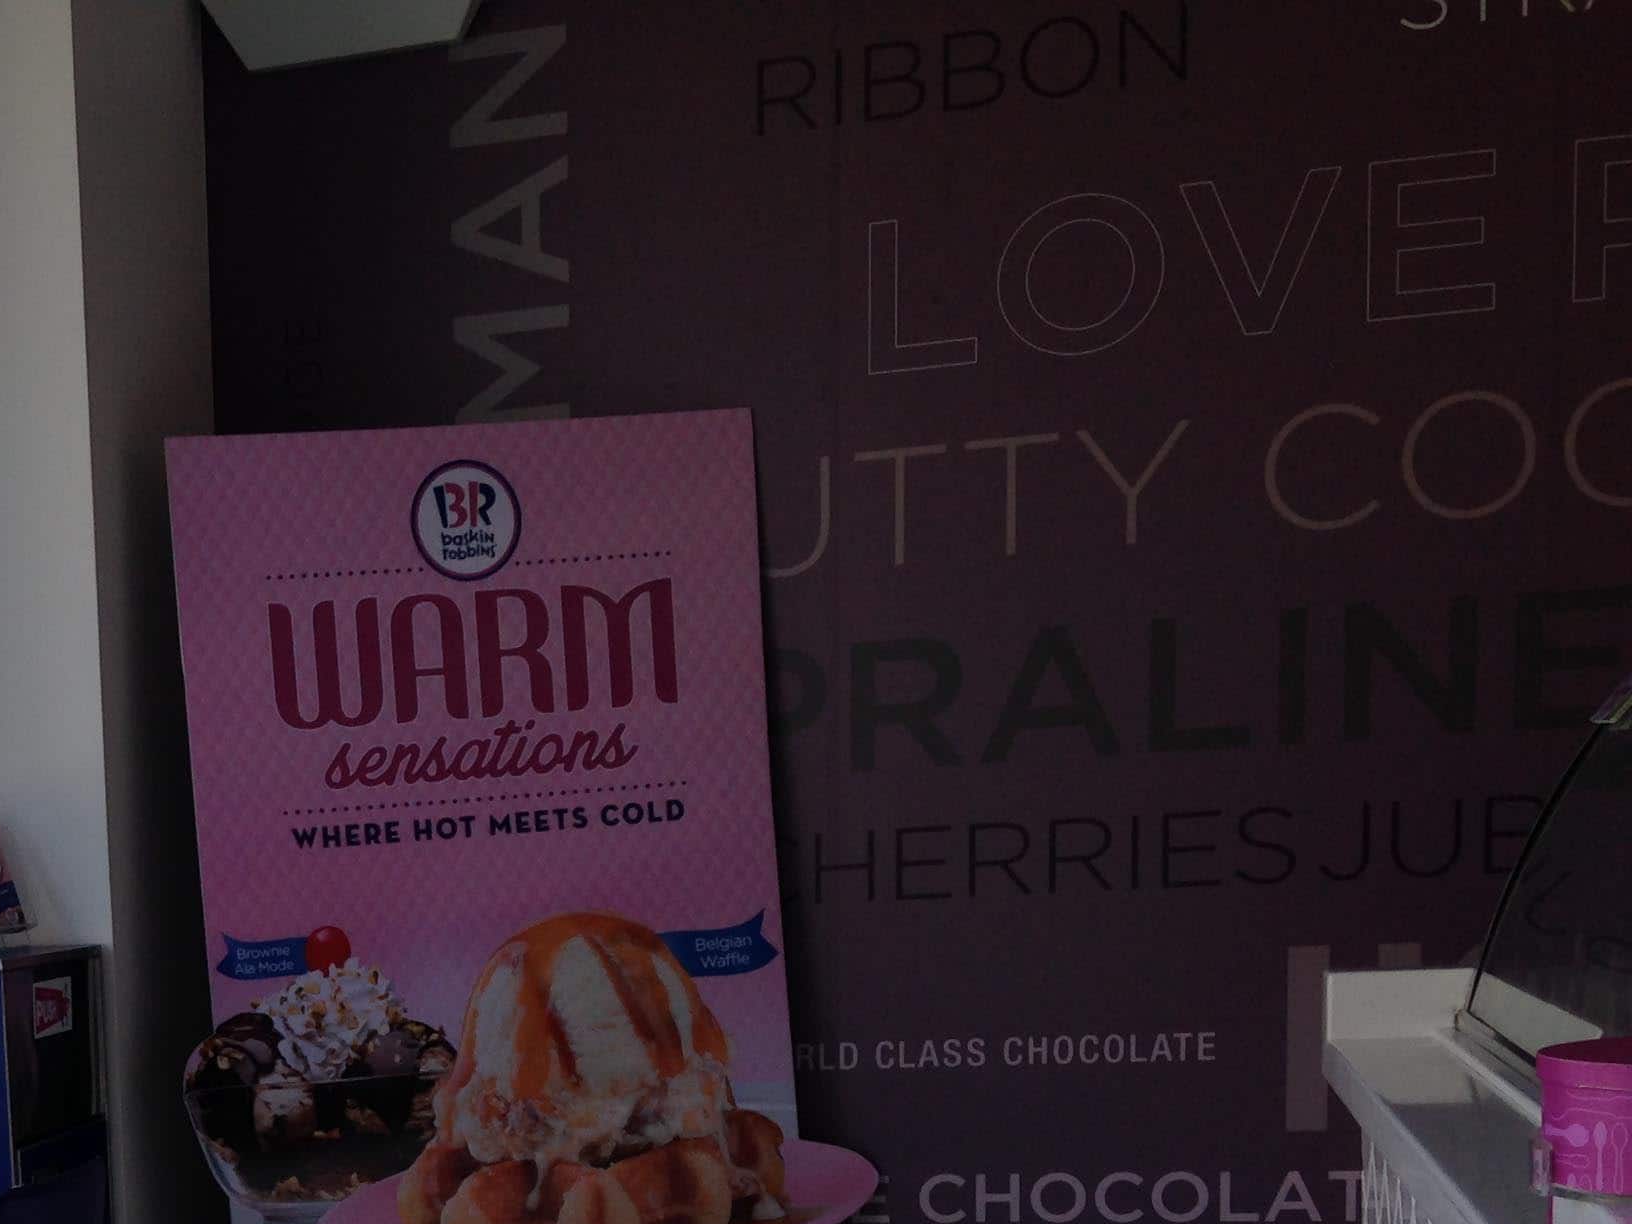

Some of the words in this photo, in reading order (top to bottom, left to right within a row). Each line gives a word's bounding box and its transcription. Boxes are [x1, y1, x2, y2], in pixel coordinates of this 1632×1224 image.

[755, 6, 1190, 137] RIBBON
[867, 148, 1497, 375] LOVE
[433, 481, 497, 530] BR
[268, 576, 679, 730] WARM
[324, 719, 639, 790] sensations
[291, 820, 401, 850] WHERE
[413, 815, 476, 841] HOT
[488, 807, 589, 836] MEETS
[600, 798, 686, 826] COLD
[778, 804, 1298, 904] HERRIES
[236, 945, 291, 961] Brownie
[694, 935, 754, 953] Belgian
[700, 951, 751, 969] Waffle
[874, 1036, 988, 1071] CLASS
[1001, 1029, 1218, 1069] CHOCOLATE
